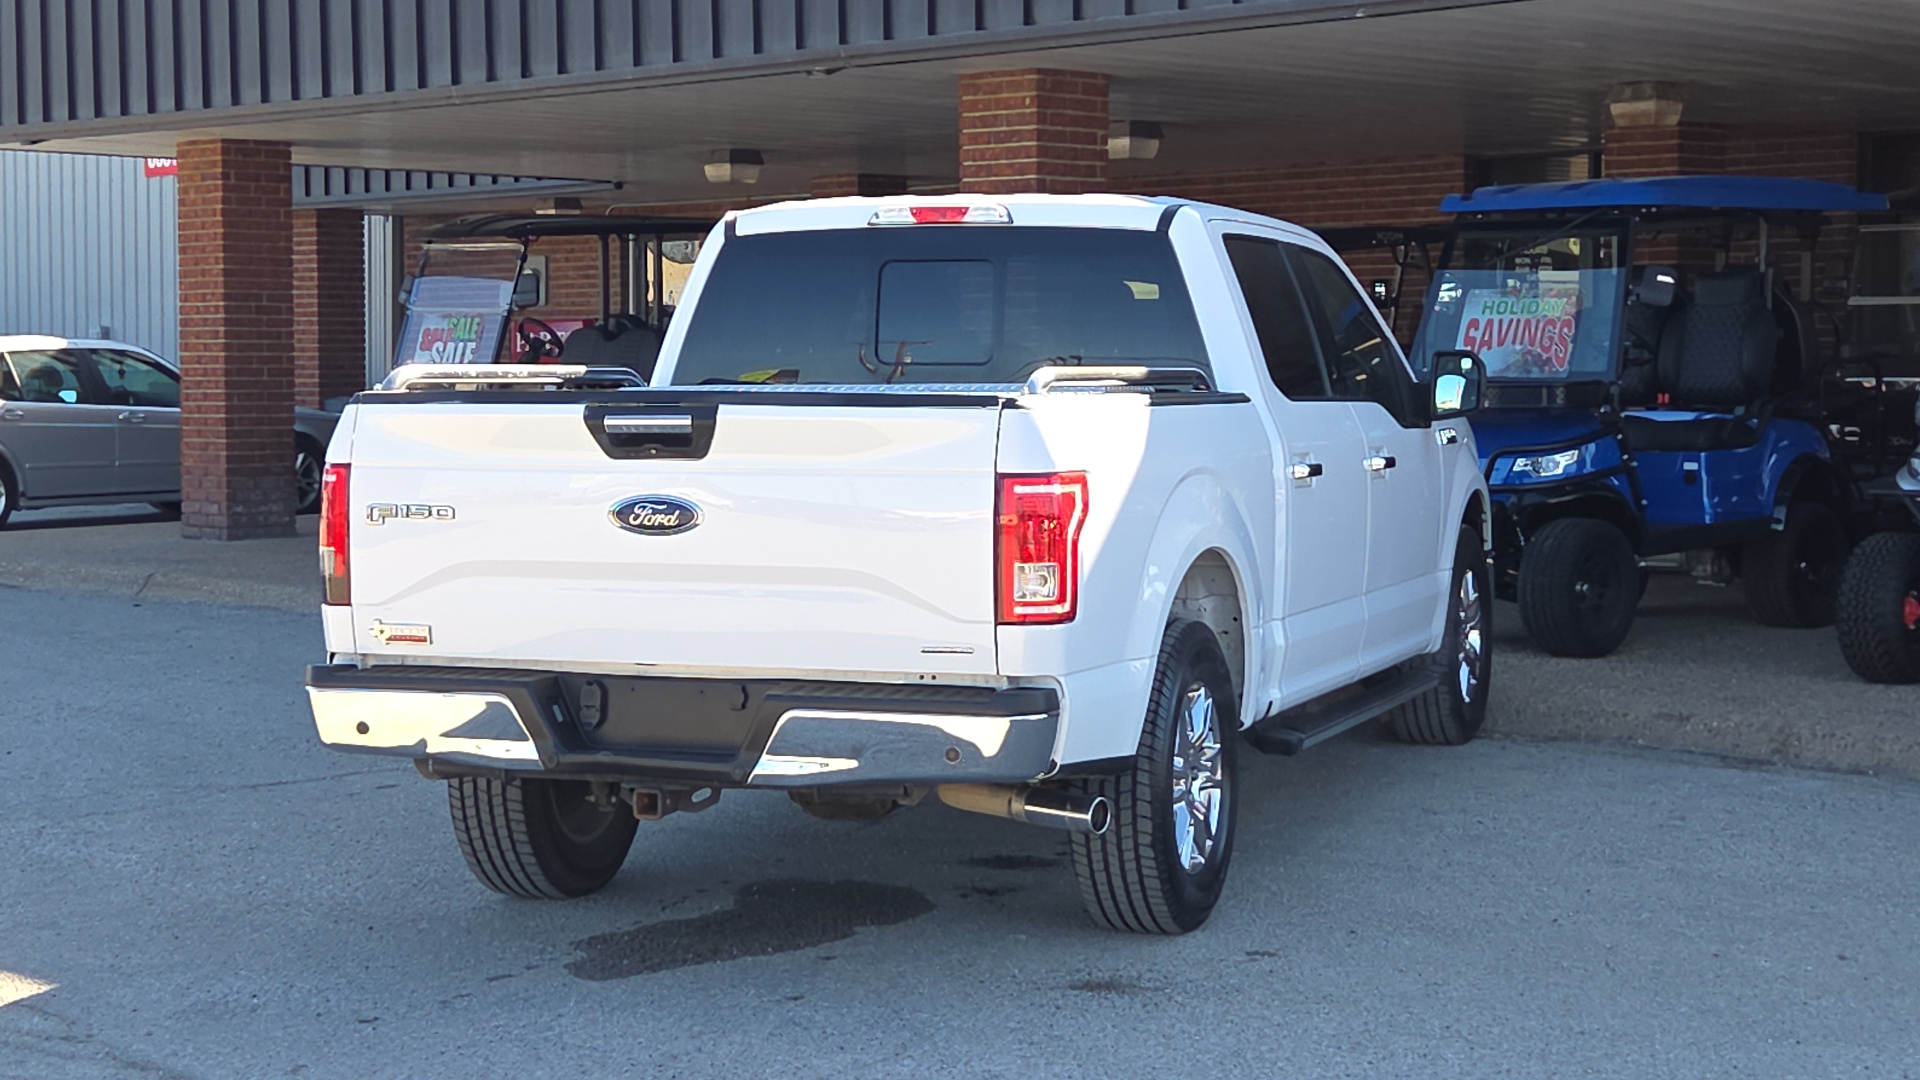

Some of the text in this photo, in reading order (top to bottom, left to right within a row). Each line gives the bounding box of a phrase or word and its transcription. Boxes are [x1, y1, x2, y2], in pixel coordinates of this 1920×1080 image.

[1481, 298, 1567, 316] HOLIDAY
[447, 316, 482, 340] SALE
[431, 341, 476, 364] SALE
[1462, 316, 1575, 371] SAVINGS
[628, 502, 681, 527] Ford
